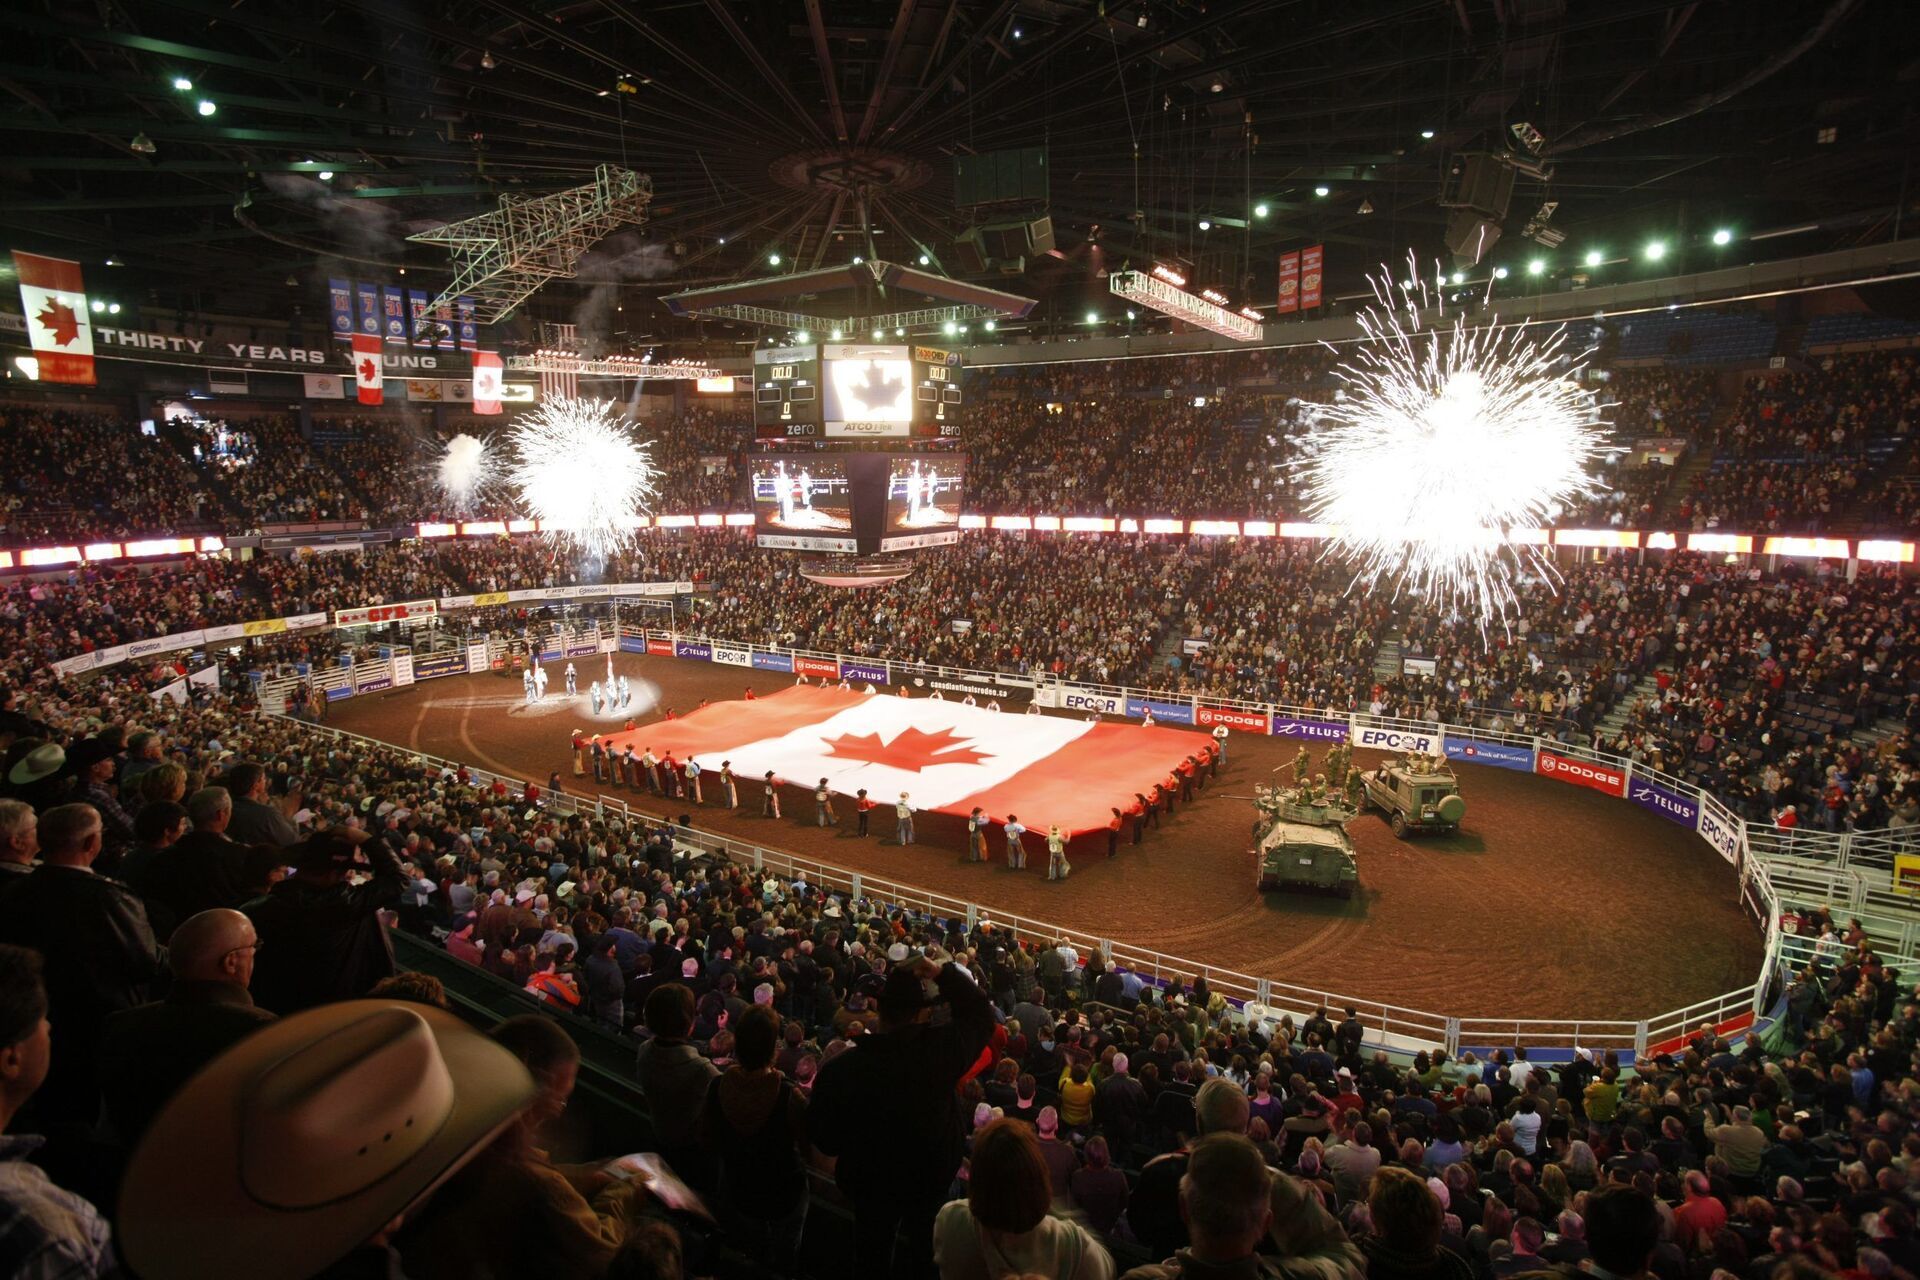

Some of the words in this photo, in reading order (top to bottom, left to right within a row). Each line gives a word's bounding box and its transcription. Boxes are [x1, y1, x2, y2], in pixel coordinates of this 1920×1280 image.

[97, 328, 204, 354] THIRTY
[228, 343, 325, 364] YEARS
[344, 351, 437, 369] YUNG
[786, 424, 815, 435] zero
[844, 422, 873, 431] ATCO
[940, 425, 961, 436] zero
[367, 605, 409, 622] CFR
[689, 648, 708, 657] TELUS
[717, 650, 746, 664] EPCOR
[805, 663, 836, 672] DODGE
[858, 671, 882, 680] TELUS
[930, 681, 1008, 698] canadianfinalsrodeo.ca
[1066, 694, 1116, 712] EPCOR
[1213, 713, 1265, 727] DODGE
[1301, 725, 1340, 738] TELUS
[1362, 730, 1430, 752] EPCOR
[1477, 750, 1492, 758] Bank
[1500, 753, 1528, 763] Montreal
[1557, 762, 1620, 786] DODGE
[1653, 794, 1690, 818] TELUS
[1701, 814, 1735, 856] EPCOR
